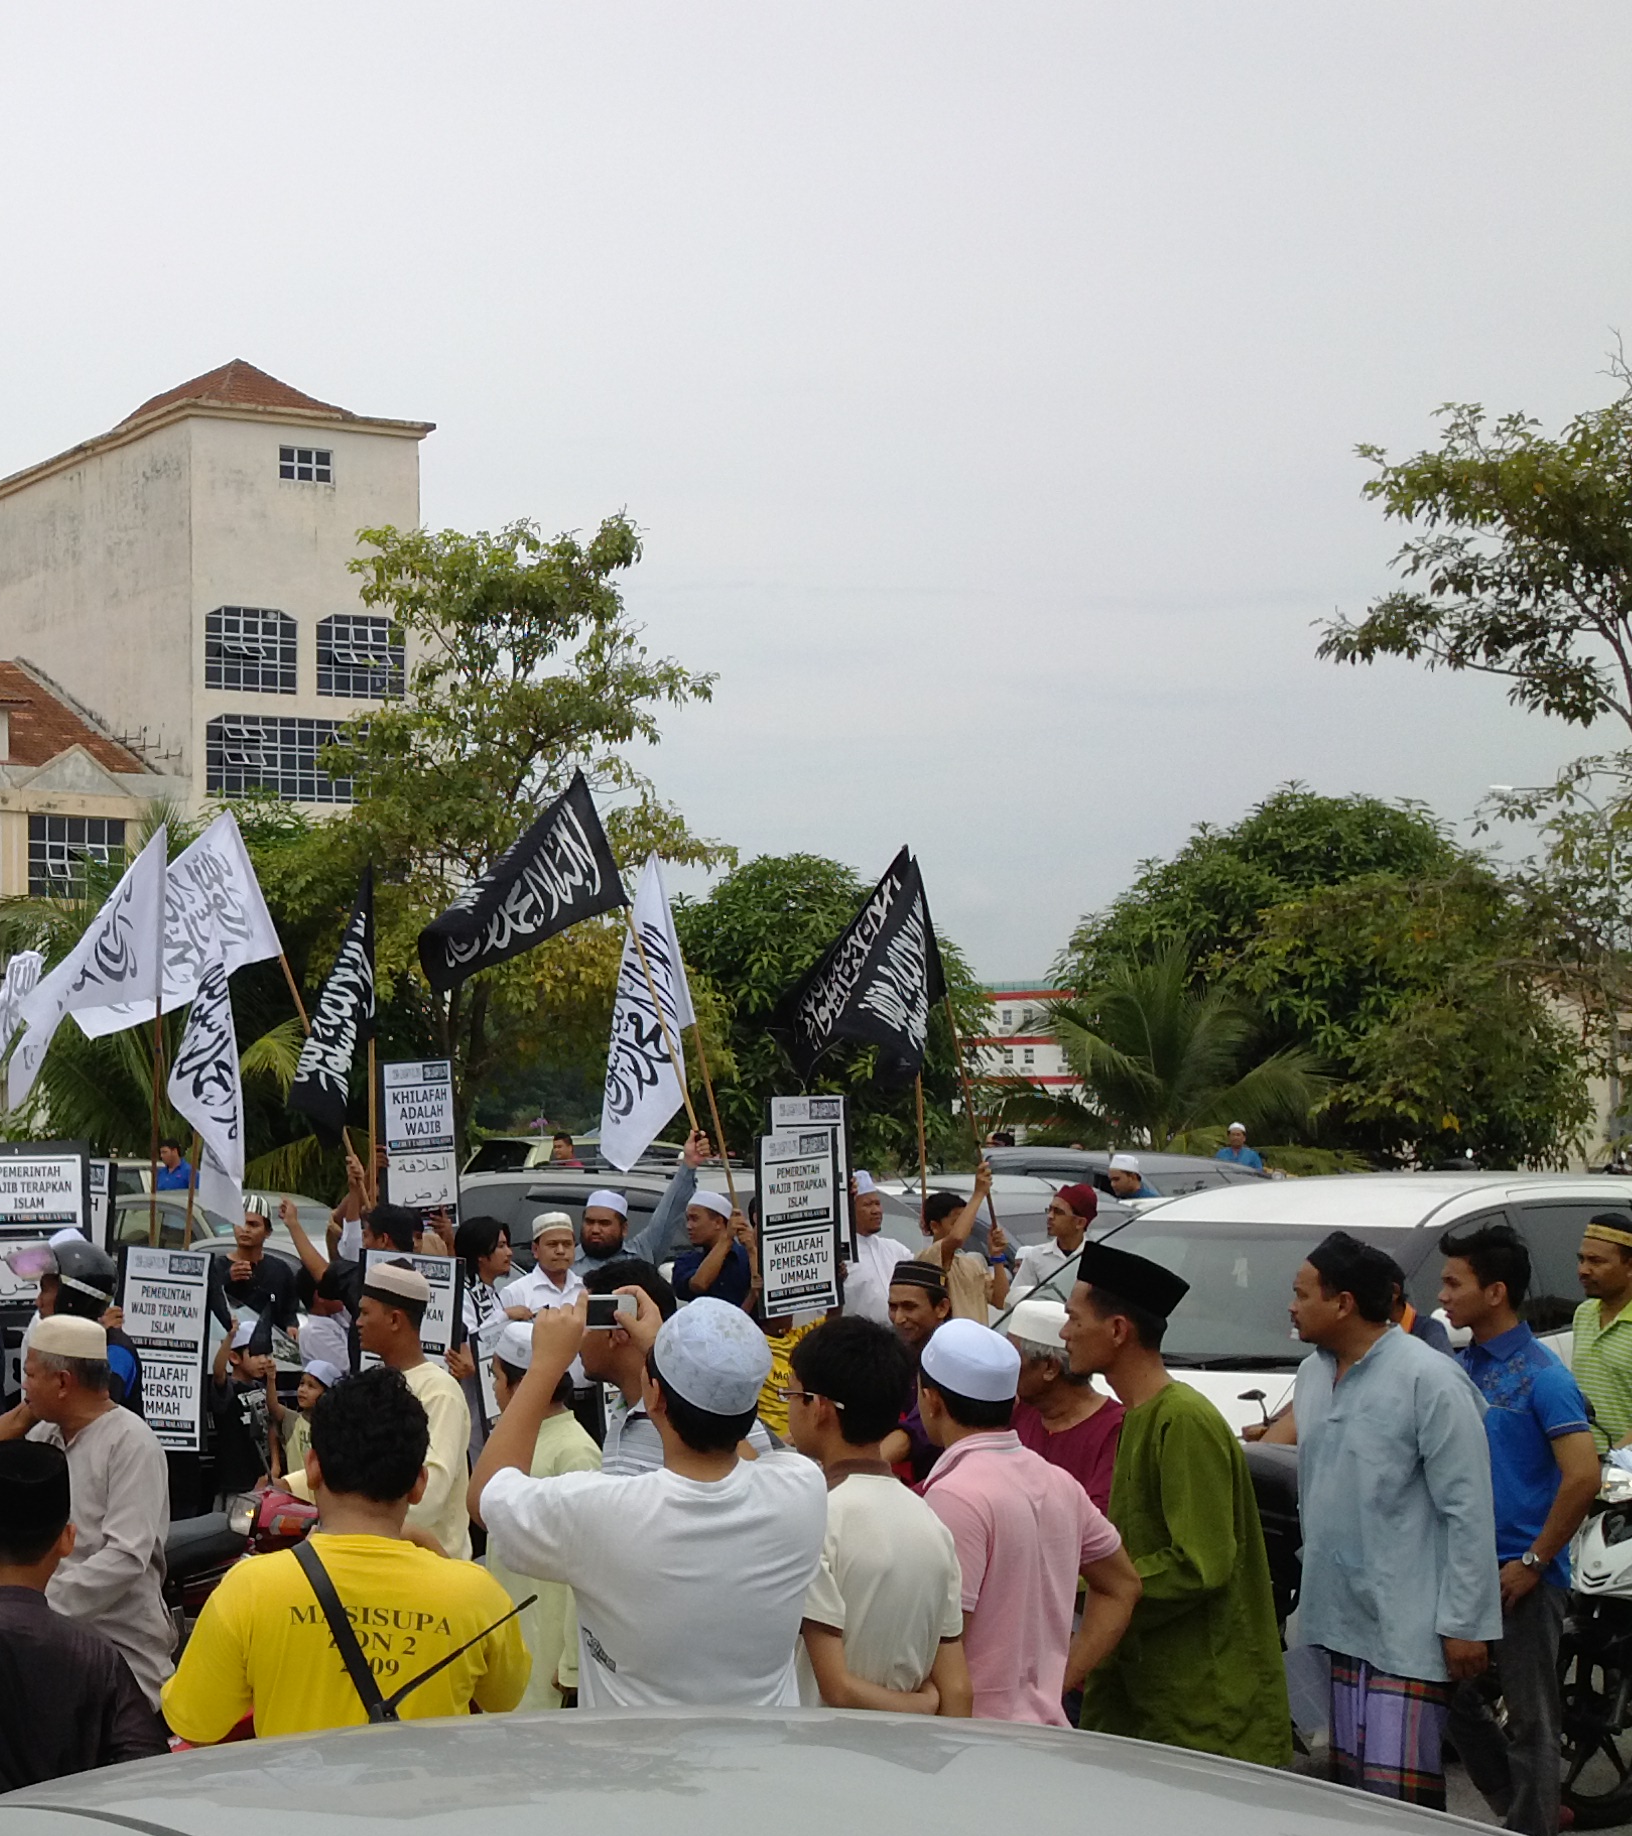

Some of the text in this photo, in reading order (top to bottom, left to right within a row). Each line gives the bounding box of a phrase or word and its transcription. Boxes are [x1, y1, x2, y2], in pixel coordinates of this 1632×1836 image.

[392, 1088, 447, 1105] KHILAFAH
[400, 1104, 444, 1120] ADALAH
[405, 1121, 441, 1136] WAJIB
[398, 1156, 449, 1173] الخلافة
[777, 1164, 820, 1179] PEMERINTAH
[20, 1181, 72, 1193] TERAPKAN
[769, 1178, 827, 1195] WAJIB TERAPKAN
[13, 1197, 44, 1209] ISLAM
[788, 1195, 808, 1208] ISLAM
[774, 1236, 824, 1255] KHILAFAH
[770, 1251, 828, 1271] PEMERSATU
[780, 1268, 818, 1284] UMMAH
[141, 1285, 191, 1301] PEMERINTAH
[131, 1302, 198, 1319] WAJIB TERAPKAN
[150, 1320, 175, 1334] ISLAM
[142, 1366, 188, 1382] HILAFAH
[145, 1401, 180, 1415] MMAH
[290, 1605, 451, 1636] MSISUPA
[402, 1636, 417, 1655] 2
